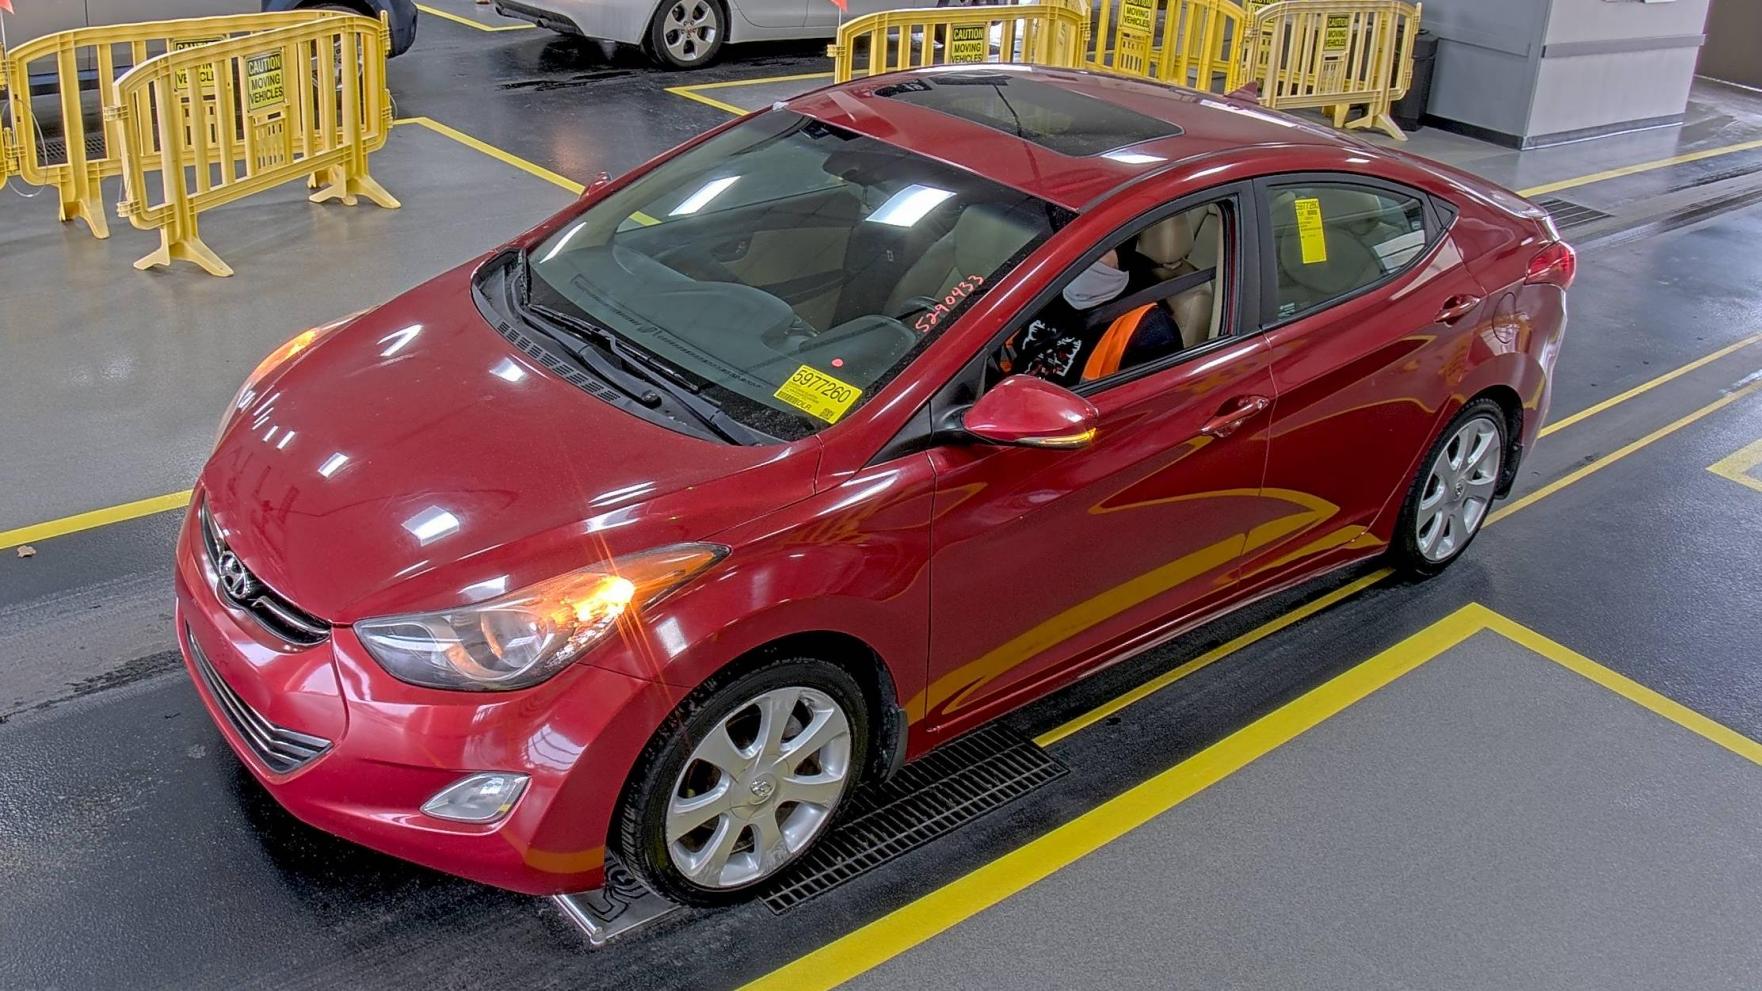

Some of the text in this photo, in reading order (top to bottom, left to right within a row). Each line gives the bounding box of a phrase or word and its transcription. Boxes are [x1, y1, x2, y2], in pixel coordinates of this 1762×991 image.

[1126, 6, 1149, 18] MOVING
[953, 28, 983, 40] CAUTION
[953, 43, 982, 53] MOVING
[248, 55, 282, 76] CAUTION
[951, 53, 984, 64] VEHICLES
[251, 73, 281, 91] MOVING
[249, 86, 284, 104] VEHICLES
[792, 369, 852, 404] 5977260
